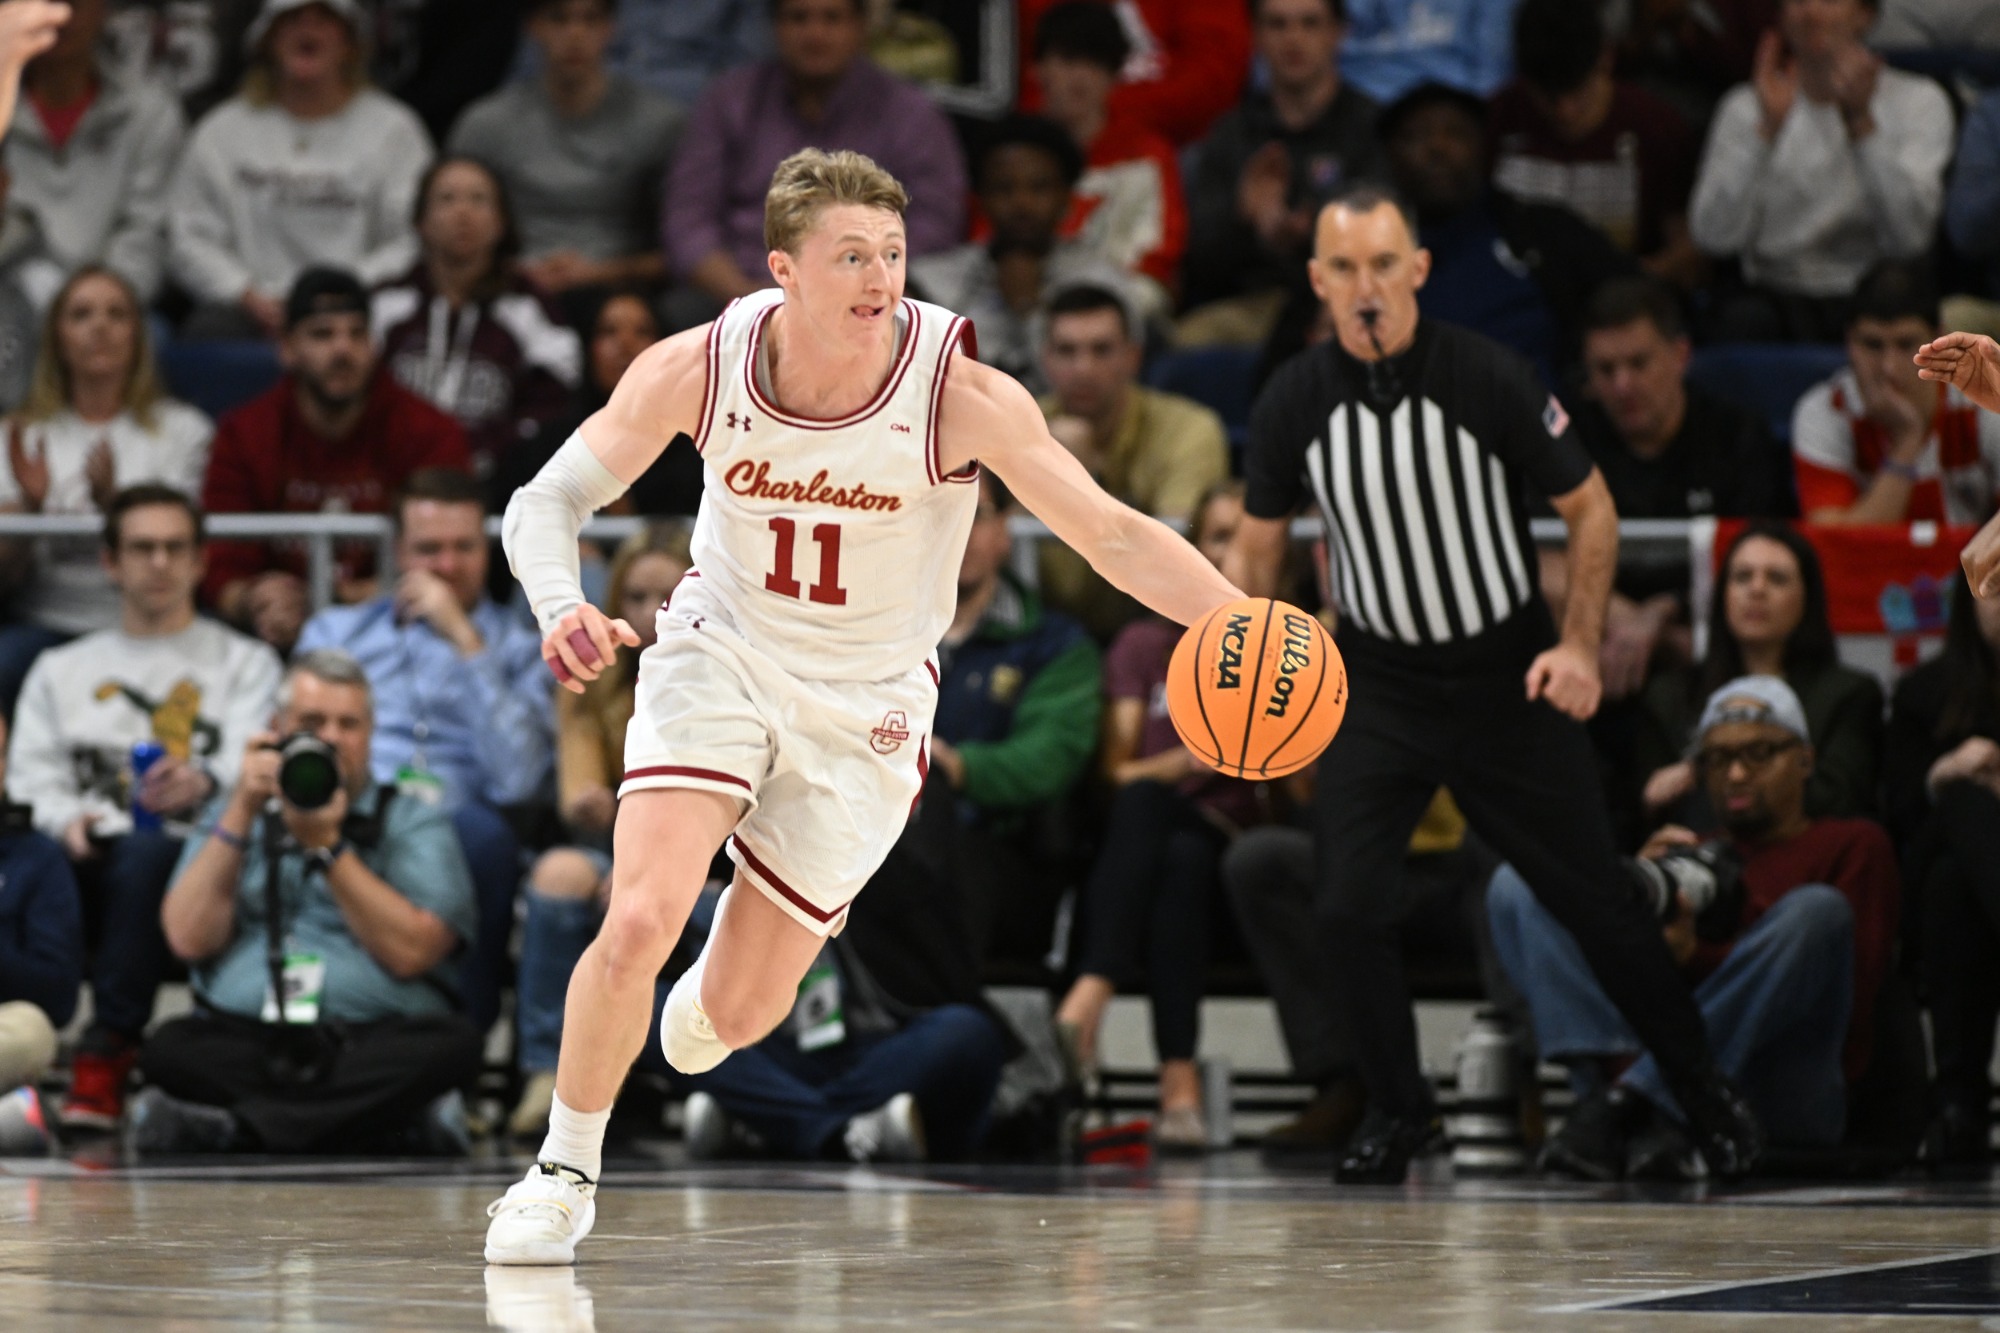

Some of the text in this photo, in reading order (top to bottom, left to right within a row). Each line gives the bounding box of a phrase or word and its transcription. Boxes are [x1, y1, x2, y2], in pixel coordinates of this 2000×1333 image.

[724, 459, 902, 512] Charleston
[765, 516, 847, 606] 11
[1216, 613, 1252, 690] NCAA
[1264, 613, 1311, 718] Wilson
